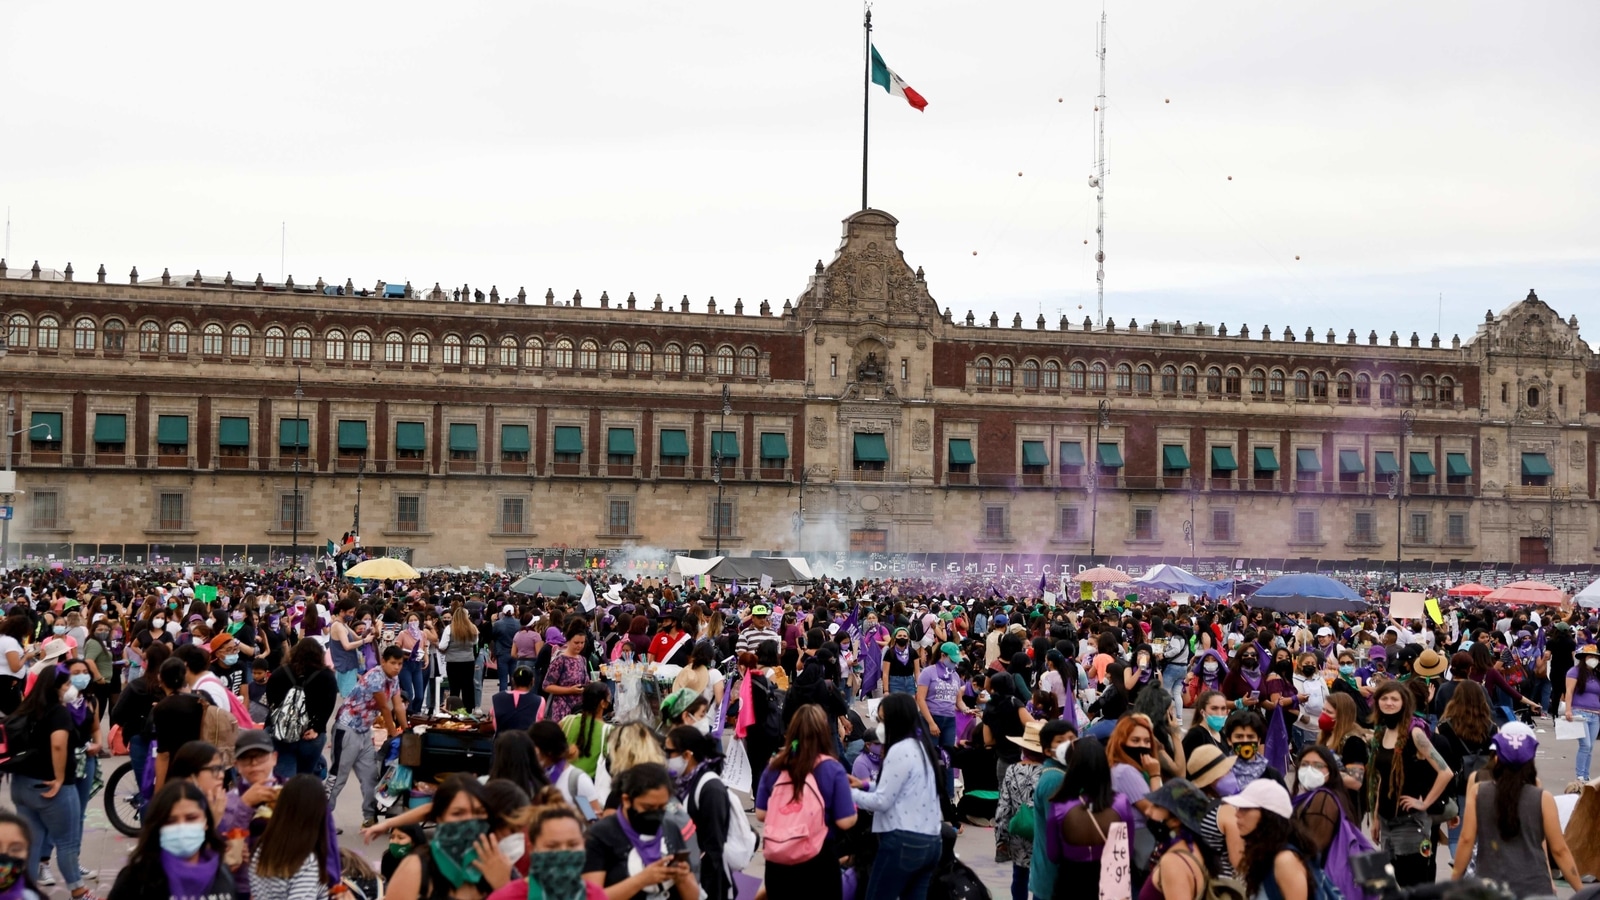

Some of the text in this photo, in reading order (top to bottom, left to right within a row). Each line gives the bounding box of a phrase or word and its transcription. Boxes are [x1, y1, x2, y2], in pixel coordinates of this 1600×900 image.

[930, 562, 1125, 575] FEMINICIDO
[661, 636, 668, 645] 3
[1113, 844, 1126, 861] te
